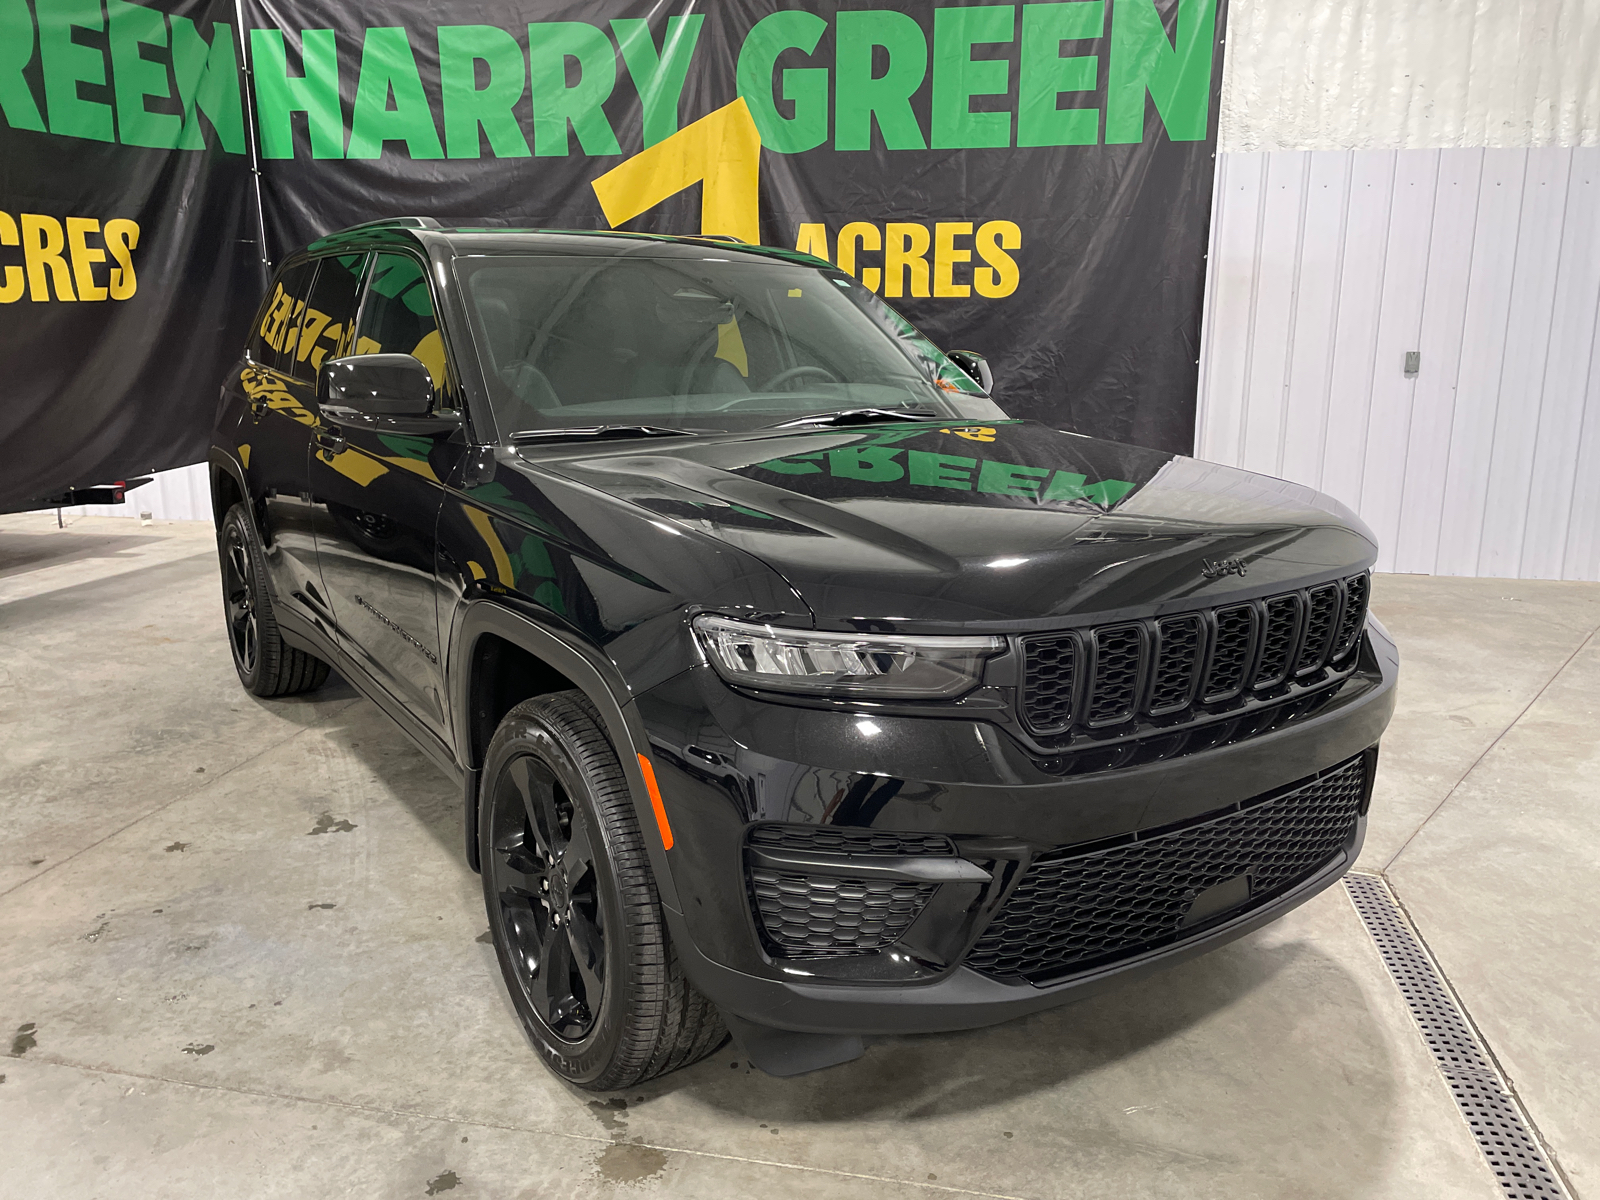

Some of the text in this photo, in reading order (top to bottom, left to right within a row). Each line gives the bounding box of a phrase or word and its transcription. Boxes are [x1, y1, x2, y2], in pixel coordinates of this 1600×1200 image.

[250, 0, 1218, 160] HARRY GREEN
[1201, 557, 1248, 578] Jeep
